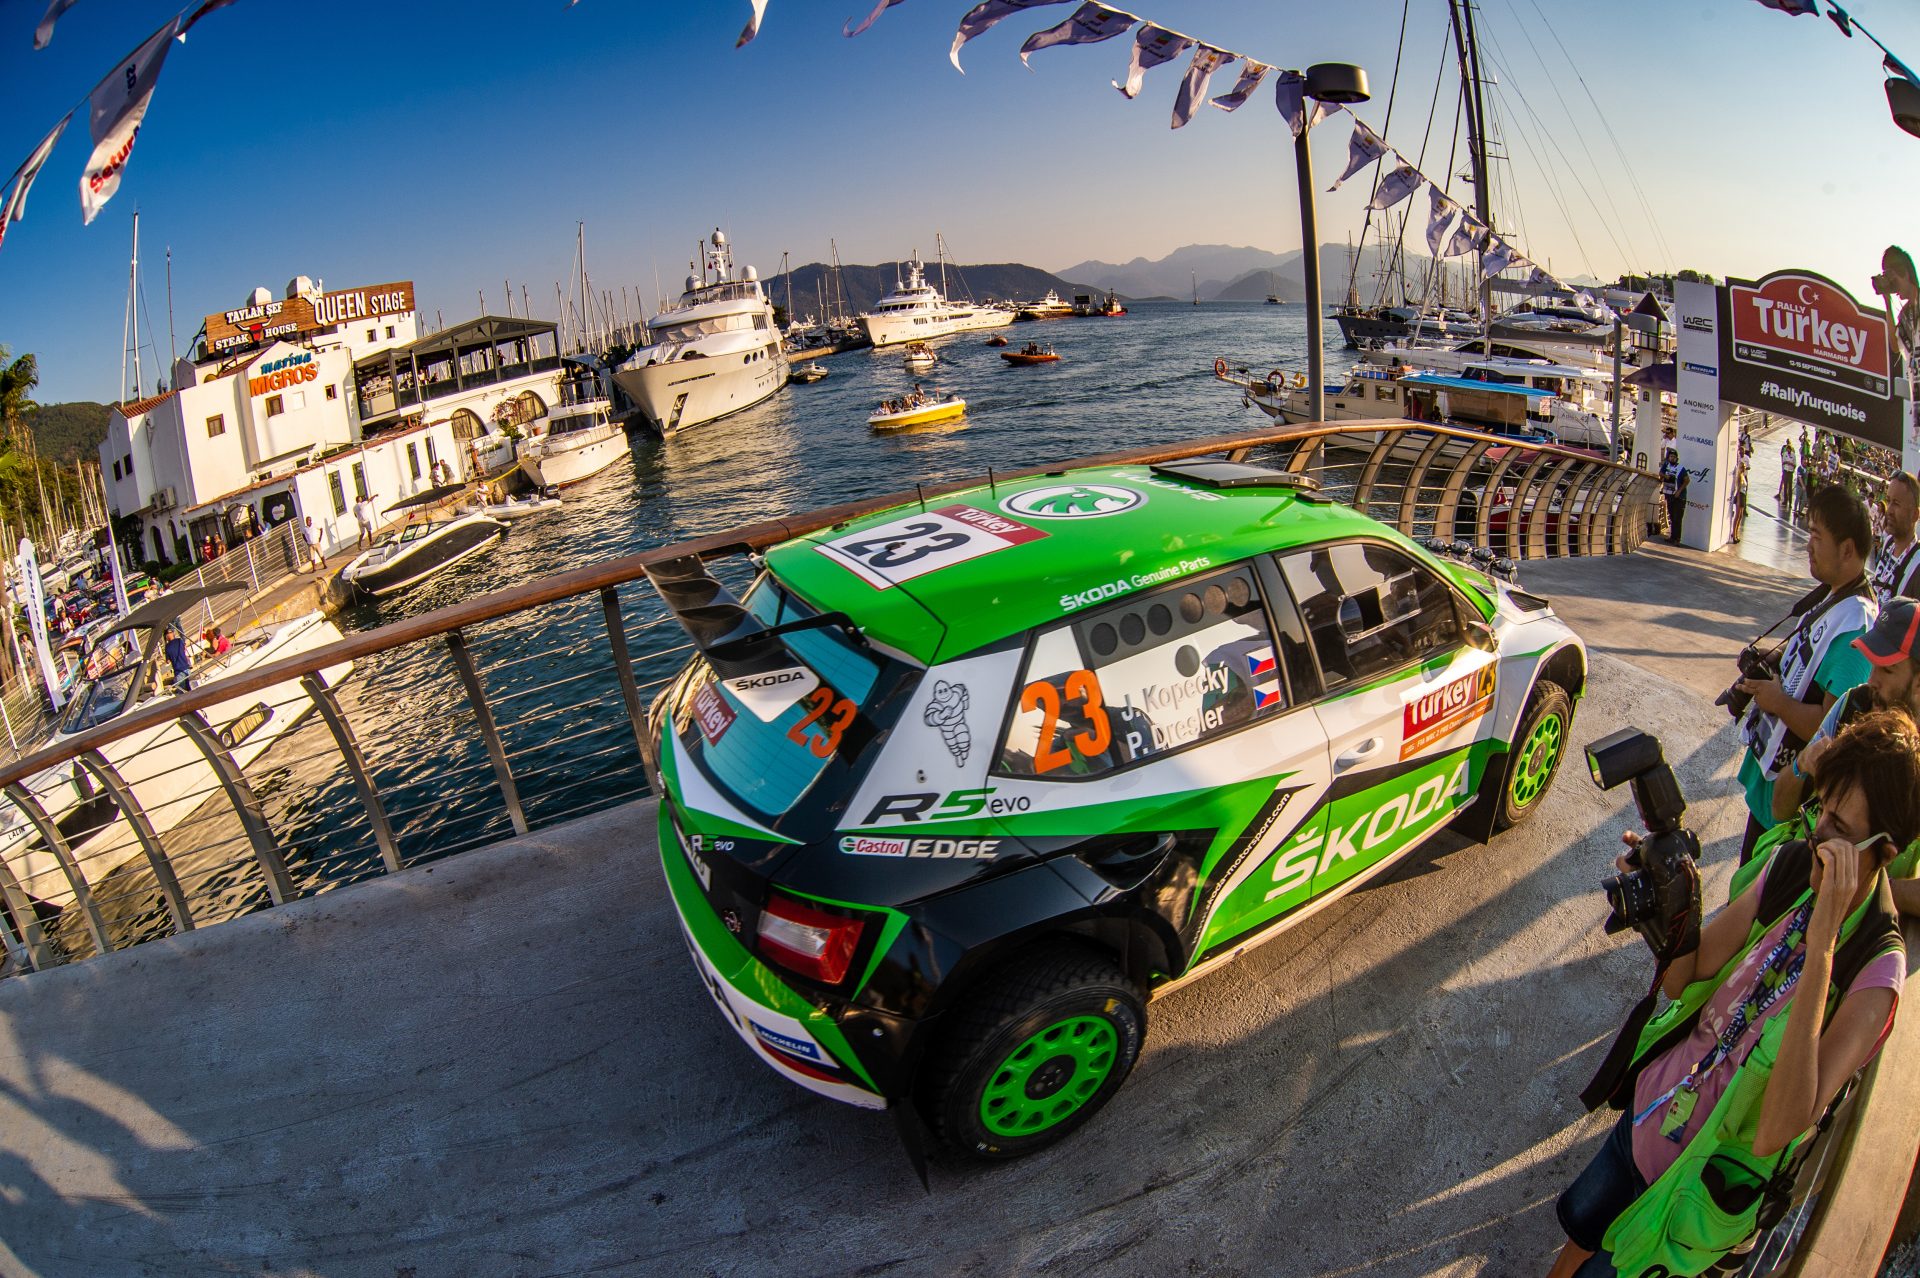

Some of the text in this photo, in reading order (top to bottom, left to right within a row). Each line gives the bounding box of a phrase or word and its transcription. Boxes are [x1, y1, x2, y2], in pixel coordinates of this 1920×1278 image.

[226, 301, 283, 324] TAYLAN ŞEF
[314, 291, 407, 327] QUEEN STAGE
[1682, 315, 1713, 327] WRC
[1776, 301, 1807, 314] RALLY
[215, 322, 298, 350] STEAK HOUSE
[1752, 296, 1868, 365] Turkey
[260, 352, 312, 376] marina
[1813, 348, 1848, 363] MARMARIS
[250, 363, 319, 398] MIGROS
[1683, 399, 1715, 411] ANONIMO
[1760, 380, 1867, 423] #RallyTurquoise
[955, 508, 1024, 534] Turkey
[841, 522, 971, 568] 23
[1059, 556, 1210, 612] ŠKODA Genuine Parts
[735, 671, 806, 692] ŠKODA
[1121, 661, 1229, 722] J. Kopecký
[1410, 674, 1475, 726] Turkey
[786, 686, 857, 759] 23
[1020, 669, 1112, 775] 23
[1126, 705, 1225, 760] P. Dresler
[860, 787, 1031, 826] R5 evo
[1263, 759, 1470, 902] ŠKODA
[856, 839, 1001, 860] Castrol EDGE
[760, 1027, 812, 1054] MICHELIN
